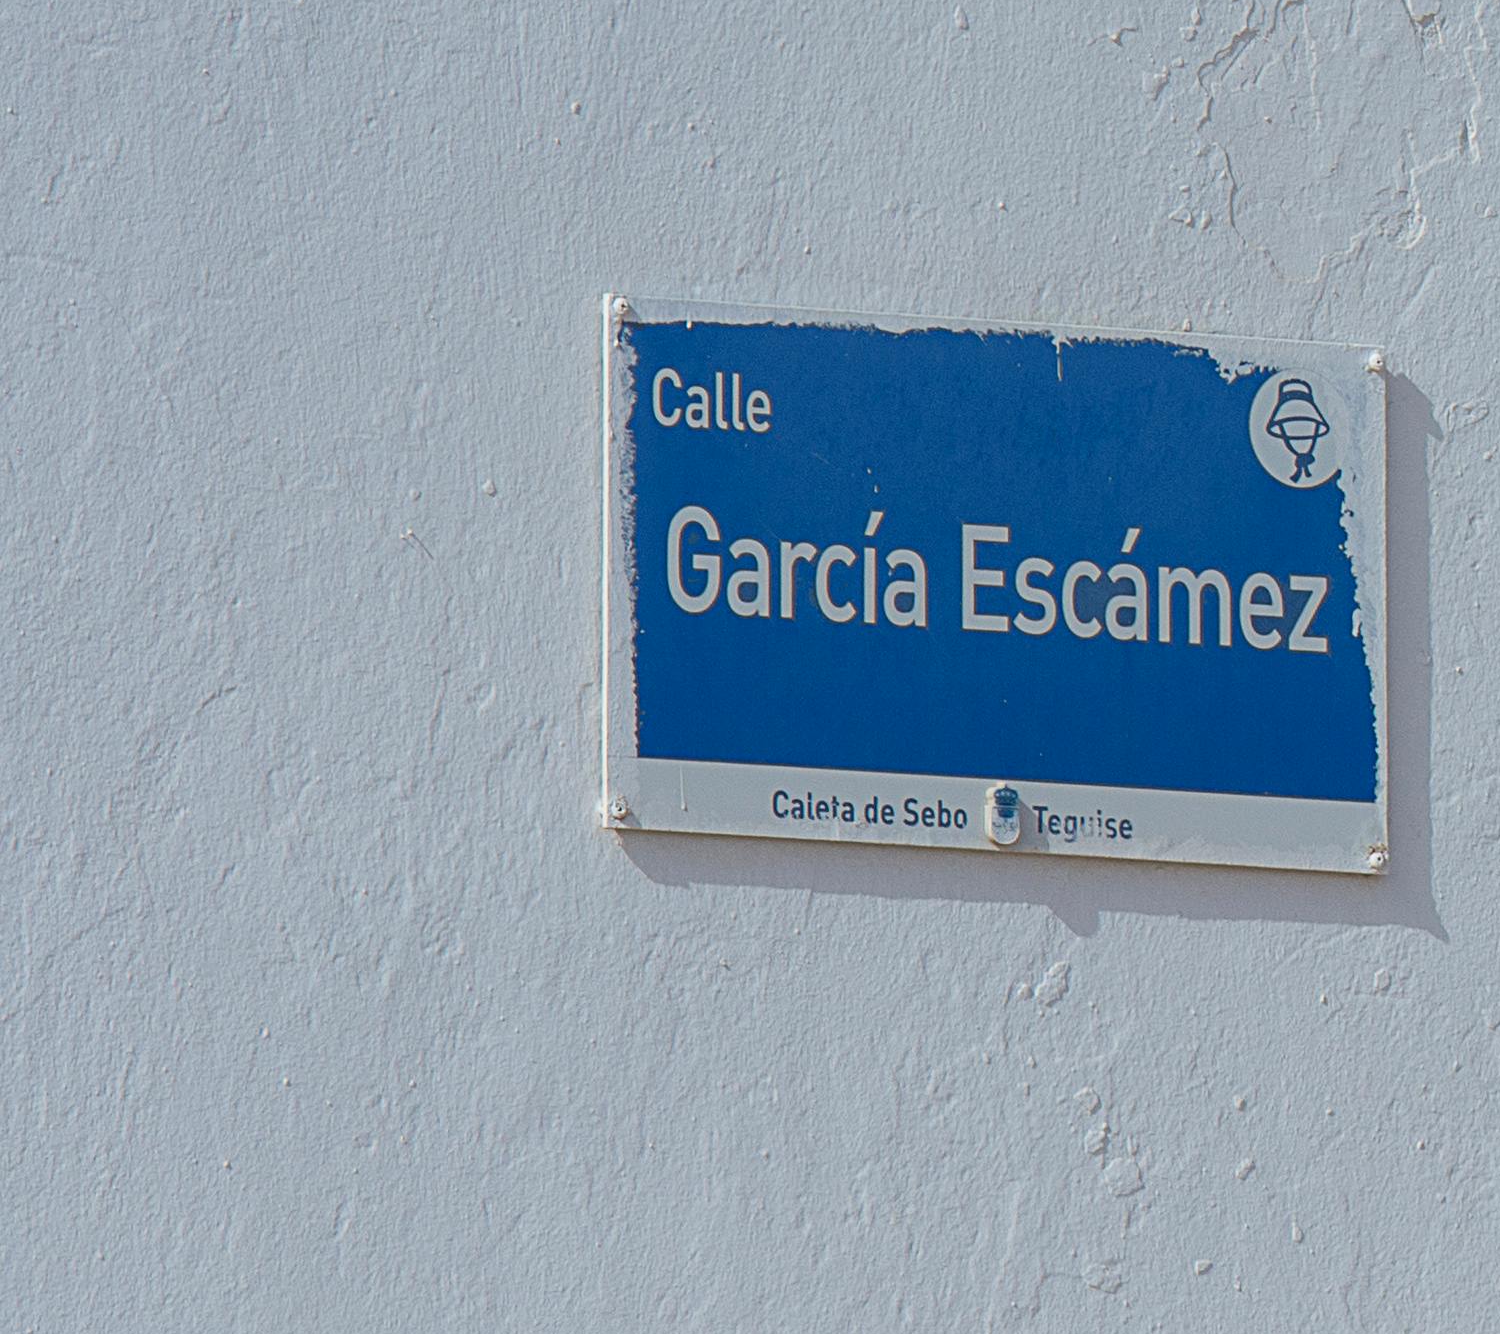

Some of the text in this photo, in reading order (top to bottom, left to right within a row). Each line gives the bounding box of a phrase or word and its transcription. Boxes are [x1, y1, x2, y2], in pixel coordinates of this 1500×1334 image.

[652, 368, 772, 433] Calle
[666, 505, 1329, 654] García Escámez
[772, 789, 969, 831] Caleta de Sebo
[1032, 805, 1134, 844] Teguise
